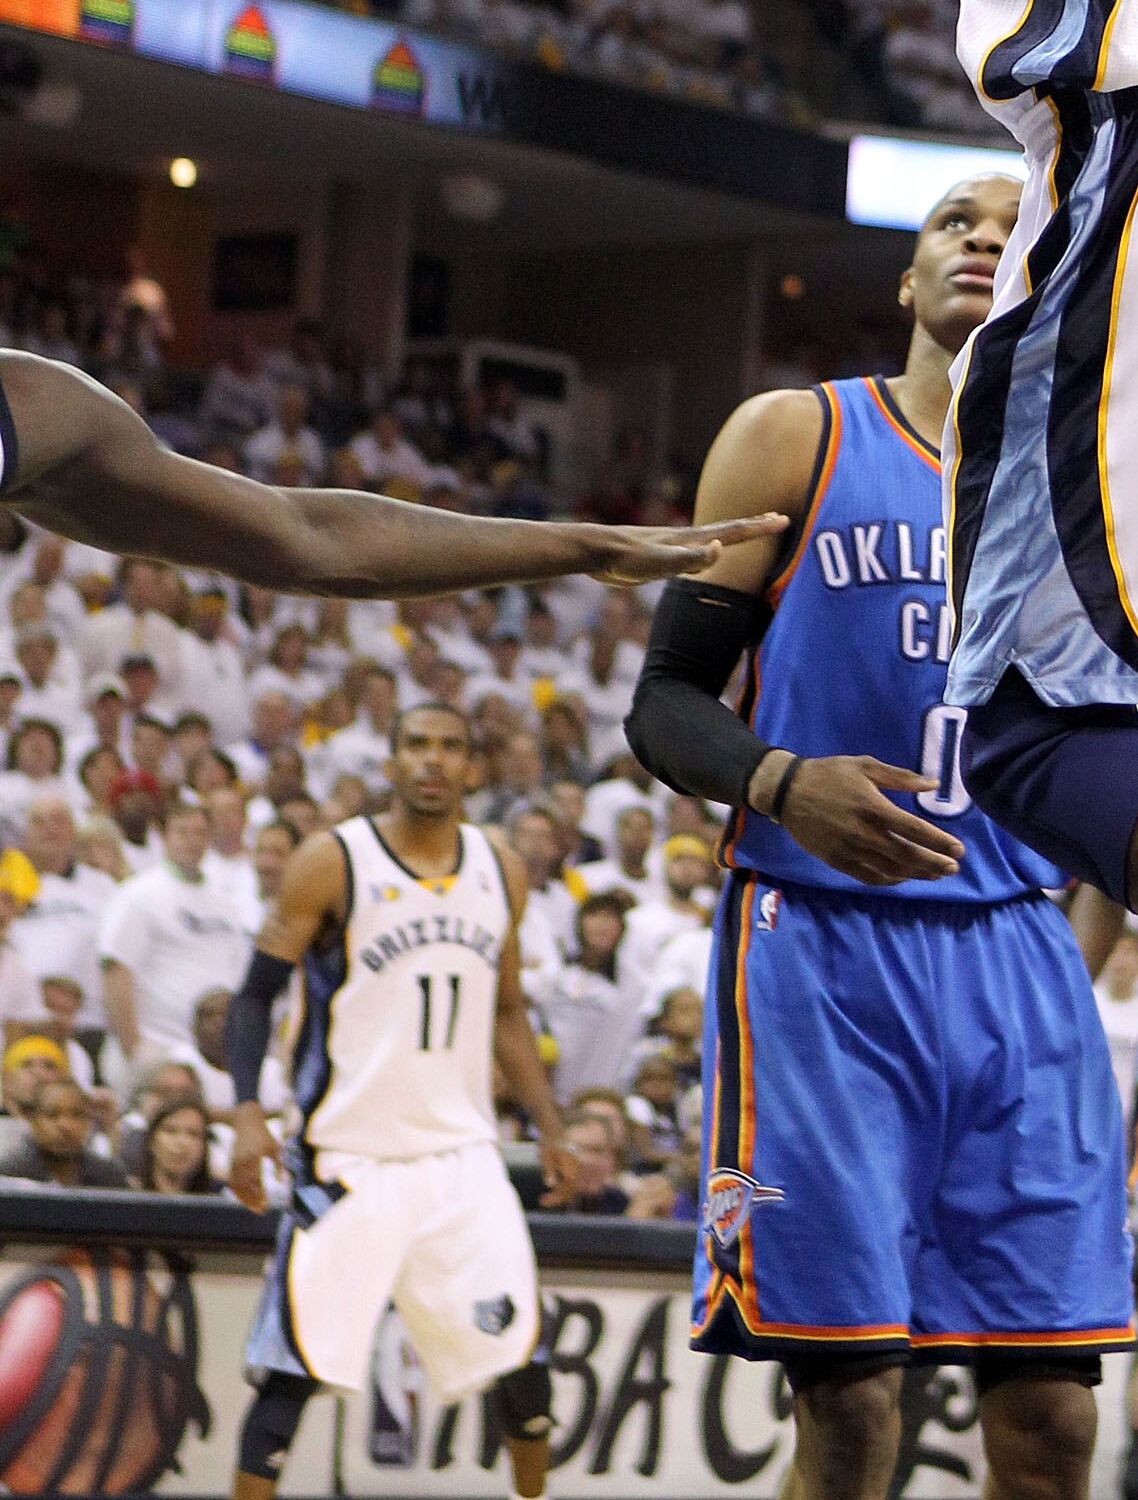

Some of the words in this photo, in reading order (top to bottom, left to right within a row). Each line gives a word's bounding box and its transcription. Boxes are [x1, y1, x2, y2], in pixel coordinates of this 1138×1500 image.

[916, 704, 972, 817] 0
[360, 914, 500, 972] GRIZZLIE
[416, 973, 462, 1052] 11
